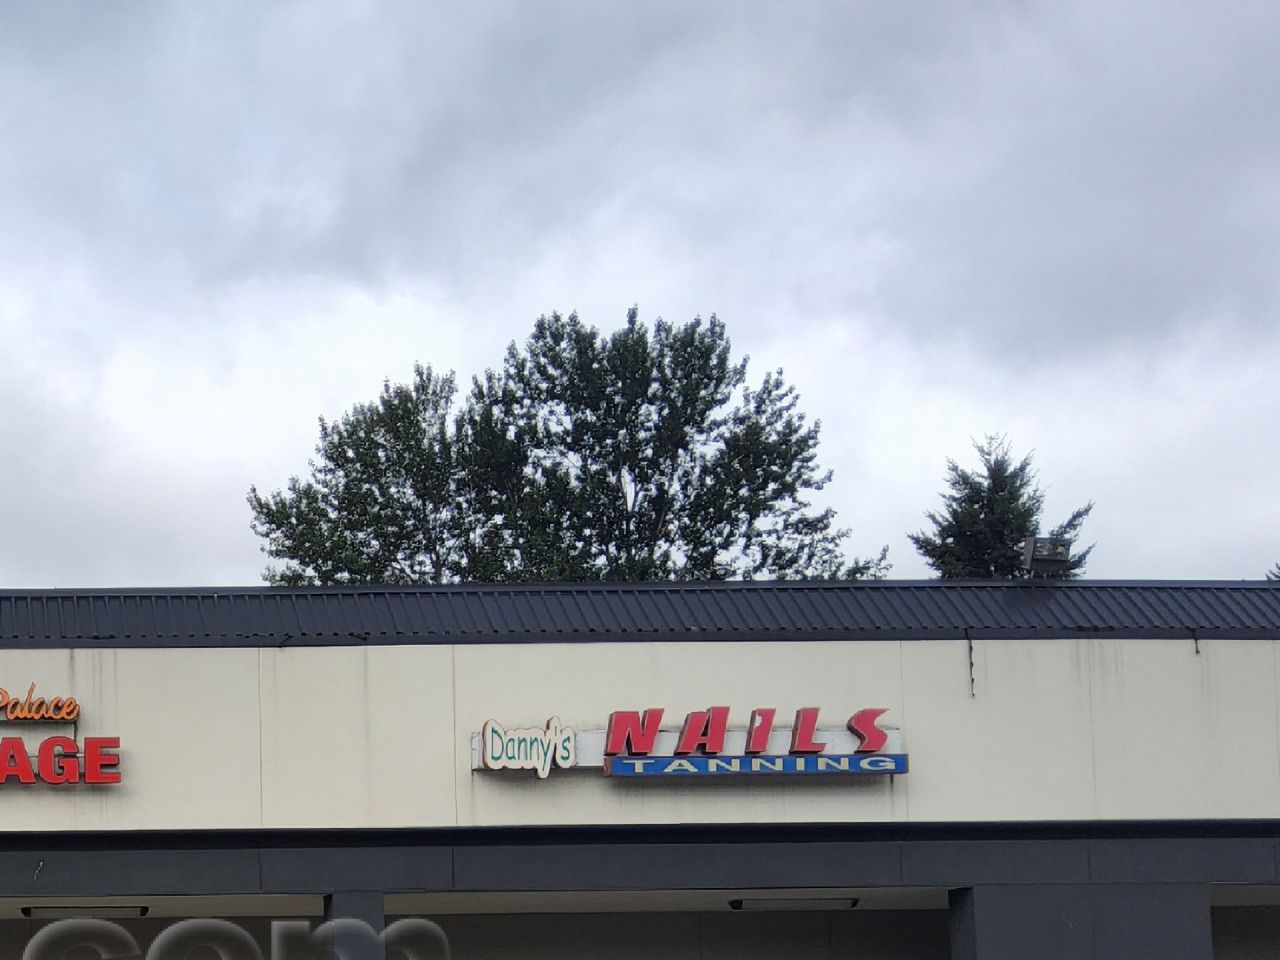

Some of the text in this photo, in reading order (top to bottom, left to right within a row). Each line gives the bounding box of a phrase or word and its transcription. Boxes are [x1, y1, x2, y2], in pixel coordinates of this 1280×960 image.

[488, 723, 572, 773] Danny's
[604, 706, 889, 756] NAILS
[623, 756, 897, 774] TANNING
